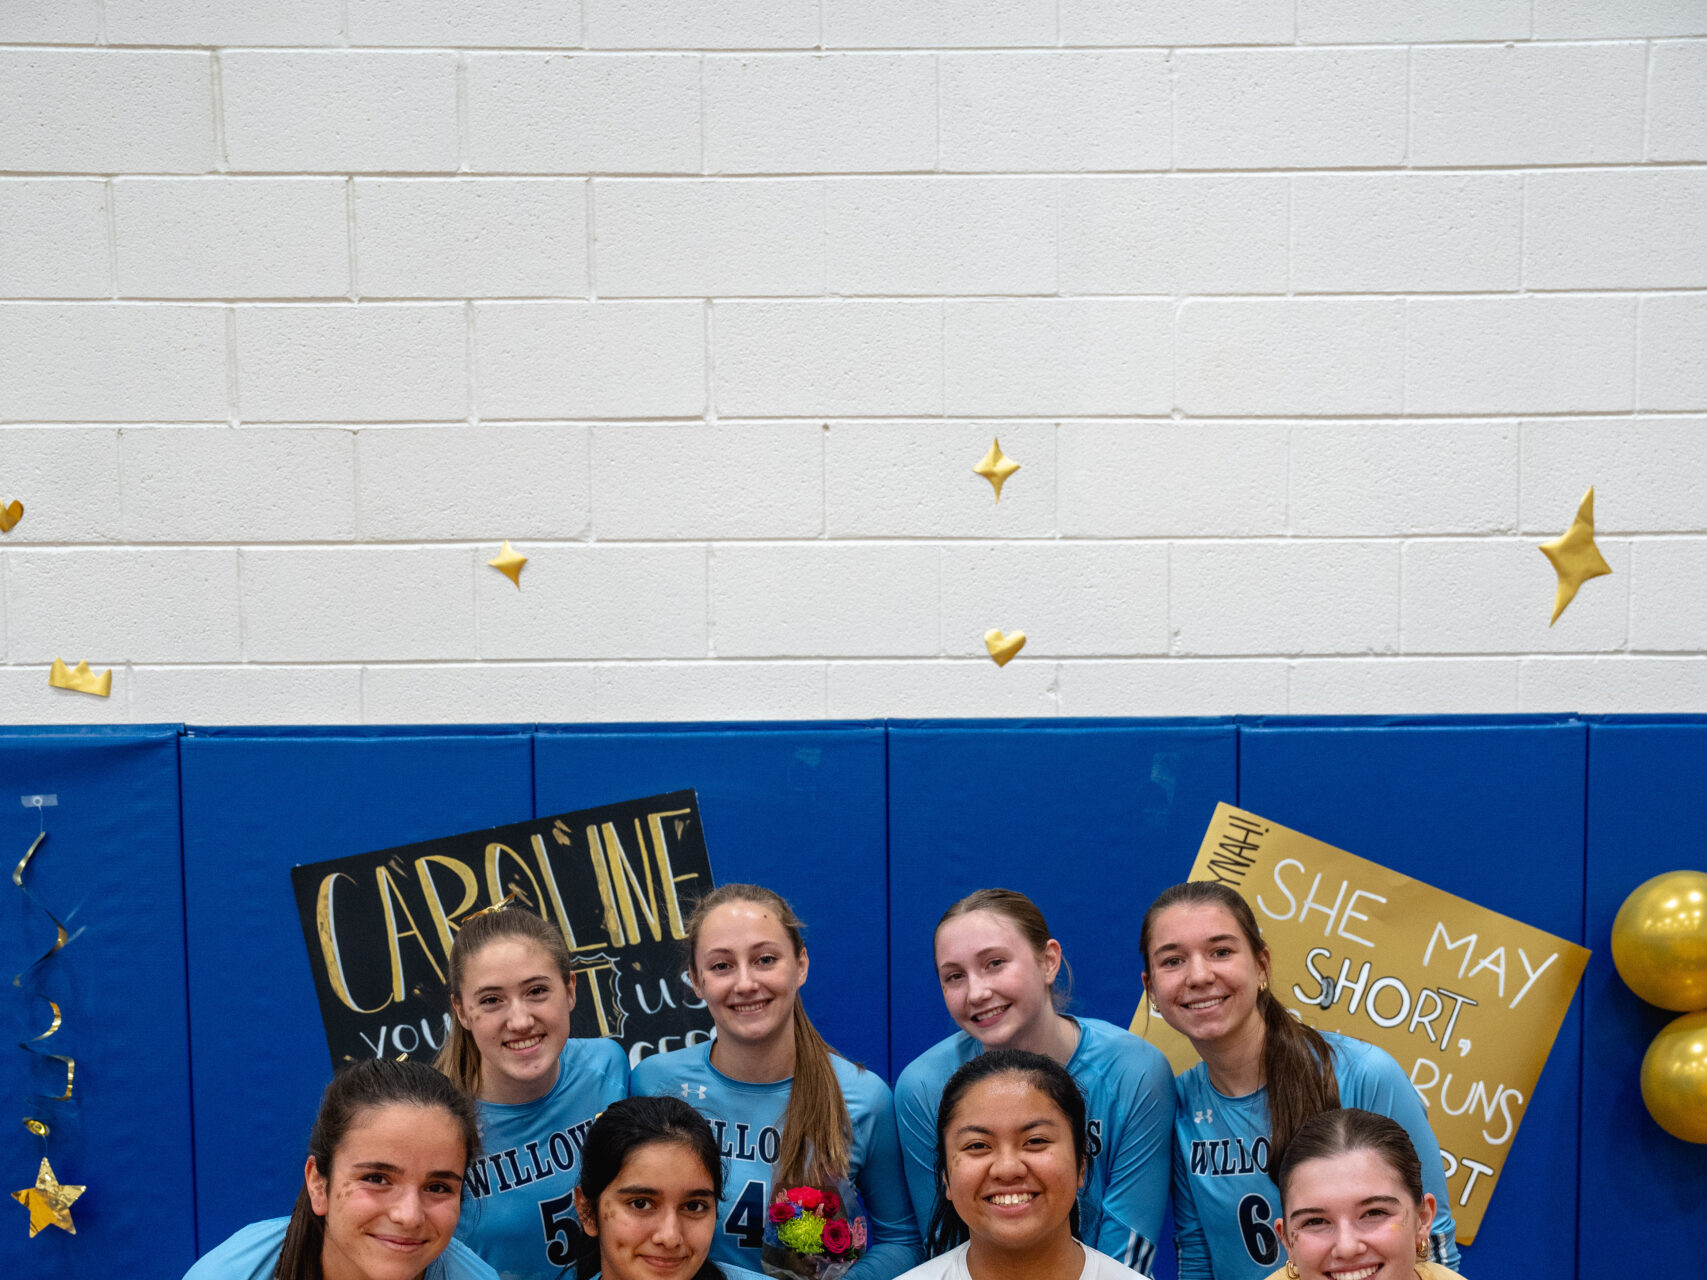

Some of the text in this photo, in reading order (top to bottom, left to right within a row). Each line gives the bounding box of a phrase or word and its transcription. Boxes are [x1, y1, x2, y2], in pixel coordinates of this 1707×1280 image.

[316, 808, 700, 1014] CAROLINE
[1257, 858, 1559, 1009] SHE MAY
[1292, 947, 1479, 1057] SHORT,
[1411, 1058, 1523, 1146] RUNS
[1190, 1135, 1272, 1178] WILLO
[537, 1188, 578, 1268] 5
[723, 1180, 767, 1250] 4
[1237, 1192, 1282, 1268] 6
